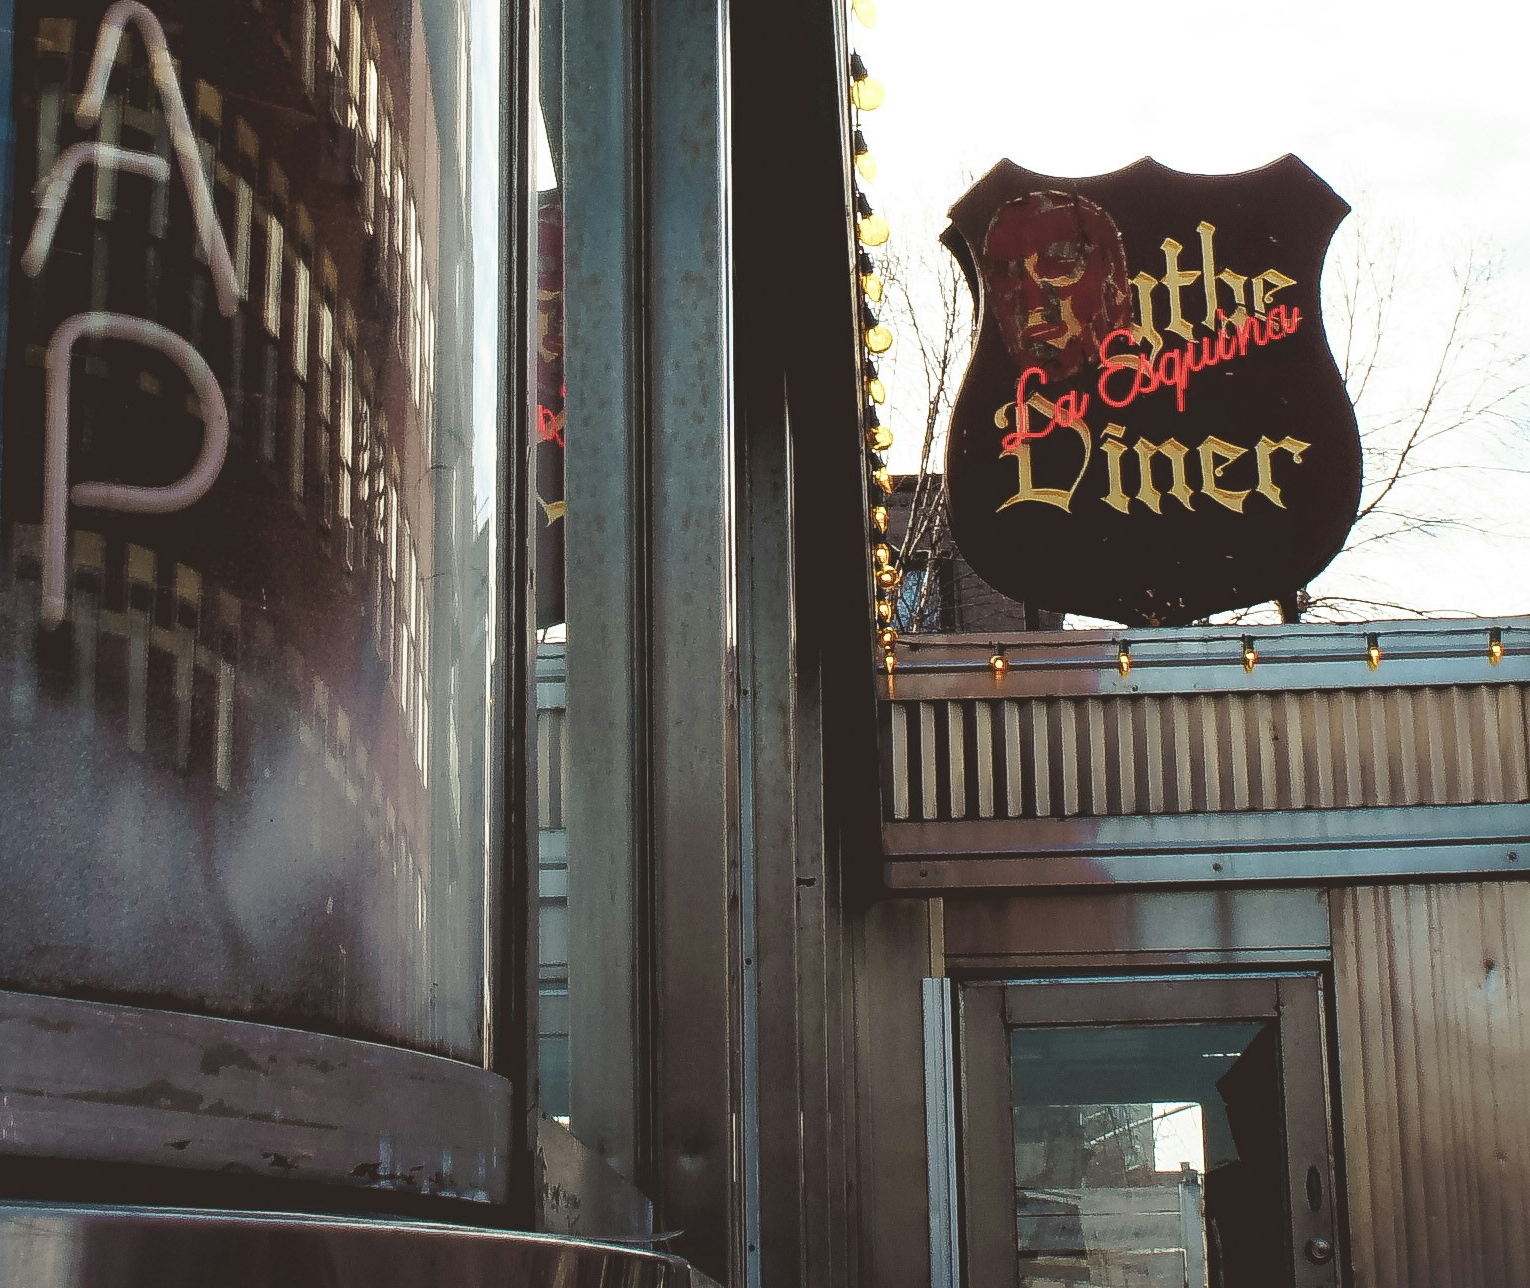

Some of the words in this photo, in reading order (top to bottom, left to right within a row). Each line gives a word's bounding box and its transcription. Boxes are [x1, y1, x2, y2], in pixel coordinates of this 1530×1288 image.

[1001, 365, 1089, 453] La
[1098, 299, 1301, 412] Esquina
[995, 391, 1312, 515] Diner
